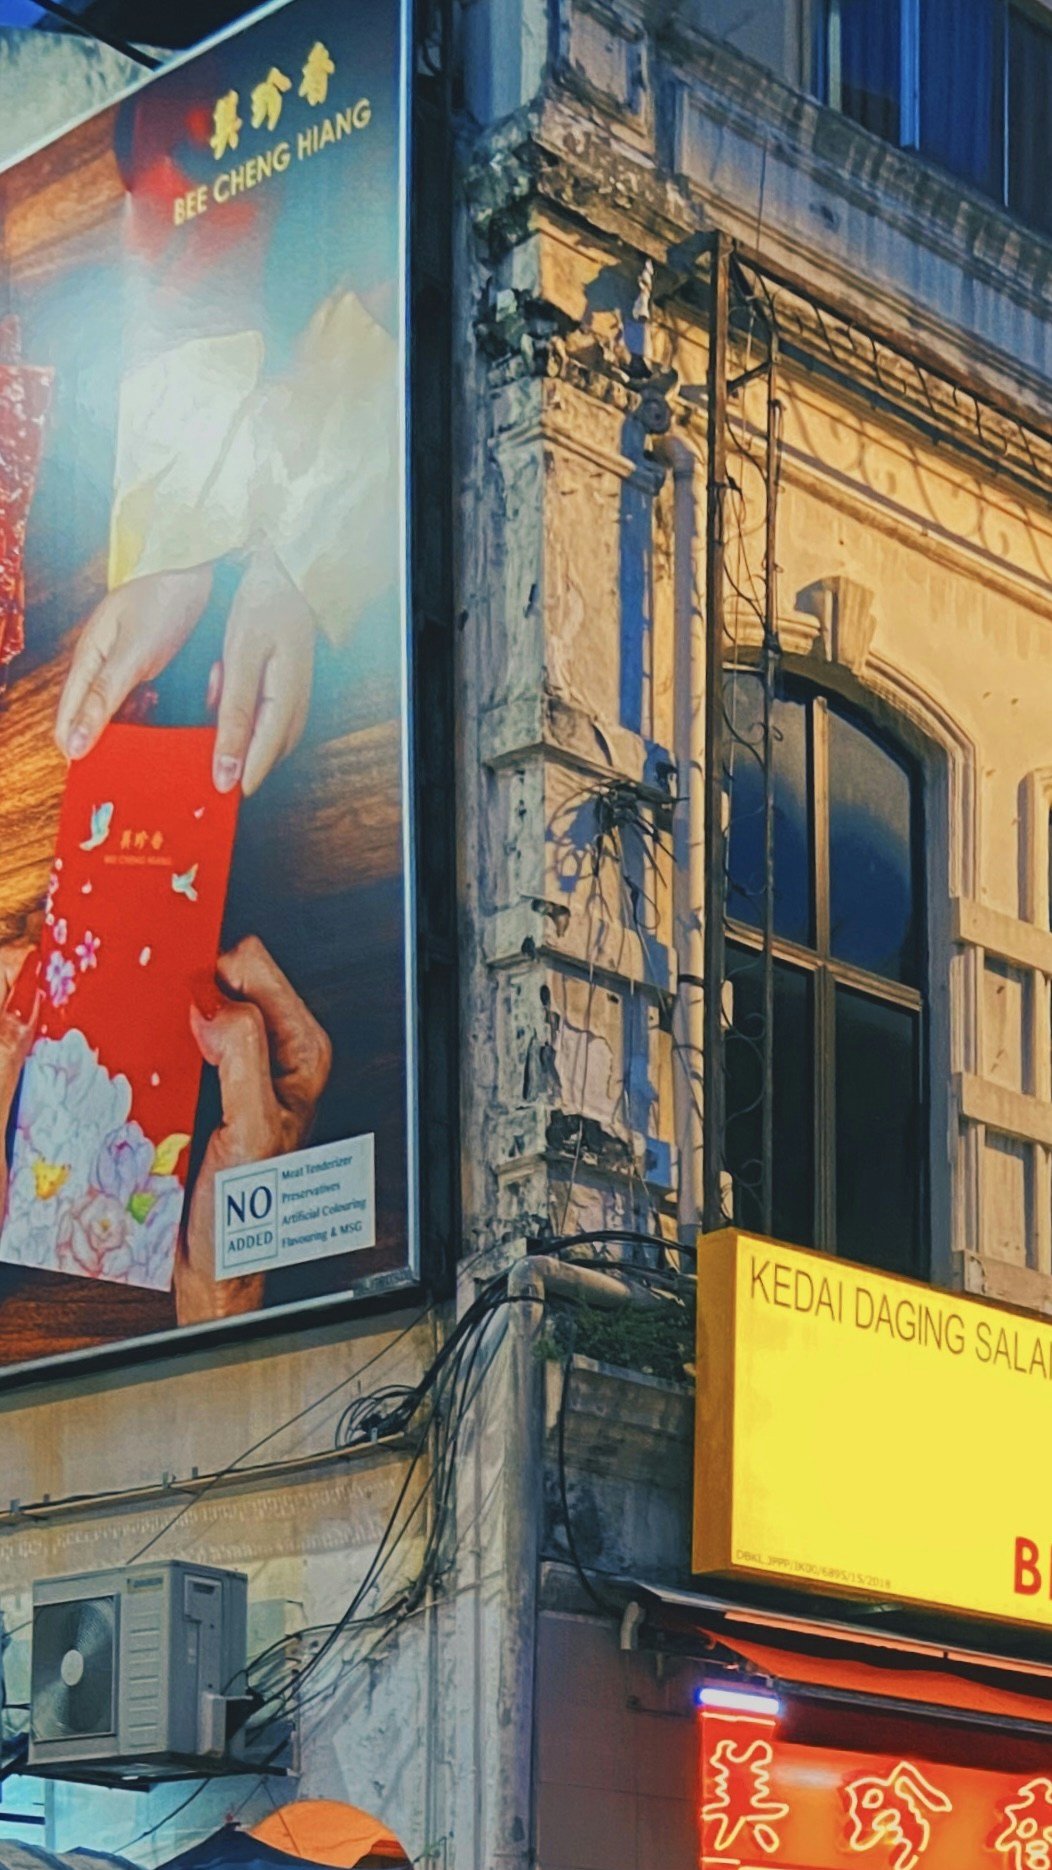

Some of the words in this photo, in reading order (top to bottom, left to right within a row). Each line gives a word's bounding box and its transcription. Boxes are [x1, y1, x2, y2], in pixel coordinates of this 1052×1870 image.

[174, 185, 208, 226] BEE
[213, 142, 290, 202] CHENG
[298, 97, 371, 160] HIANG
[282, 1166, 303, 1180] Meat
[306, 1156, 353, 1173] Tenderizer
[282, 1181, 341, 1203] Preservatives
[227, 1186, 273, 1226] NO
[282, 1207, 320, 1225] Artificial
[322, 1197, 367, 1217] Colouring
[228, 1231, 273, 1253] ADDED
[282, 1230, 327, 1248] Flavouring
[330, 1227, 338, 1238] &
[340, 1221, 363, 1234] MSG
[751, 1256, 843, 1323] KEDAI
[855, 1286, 965, 1356] DAGING
